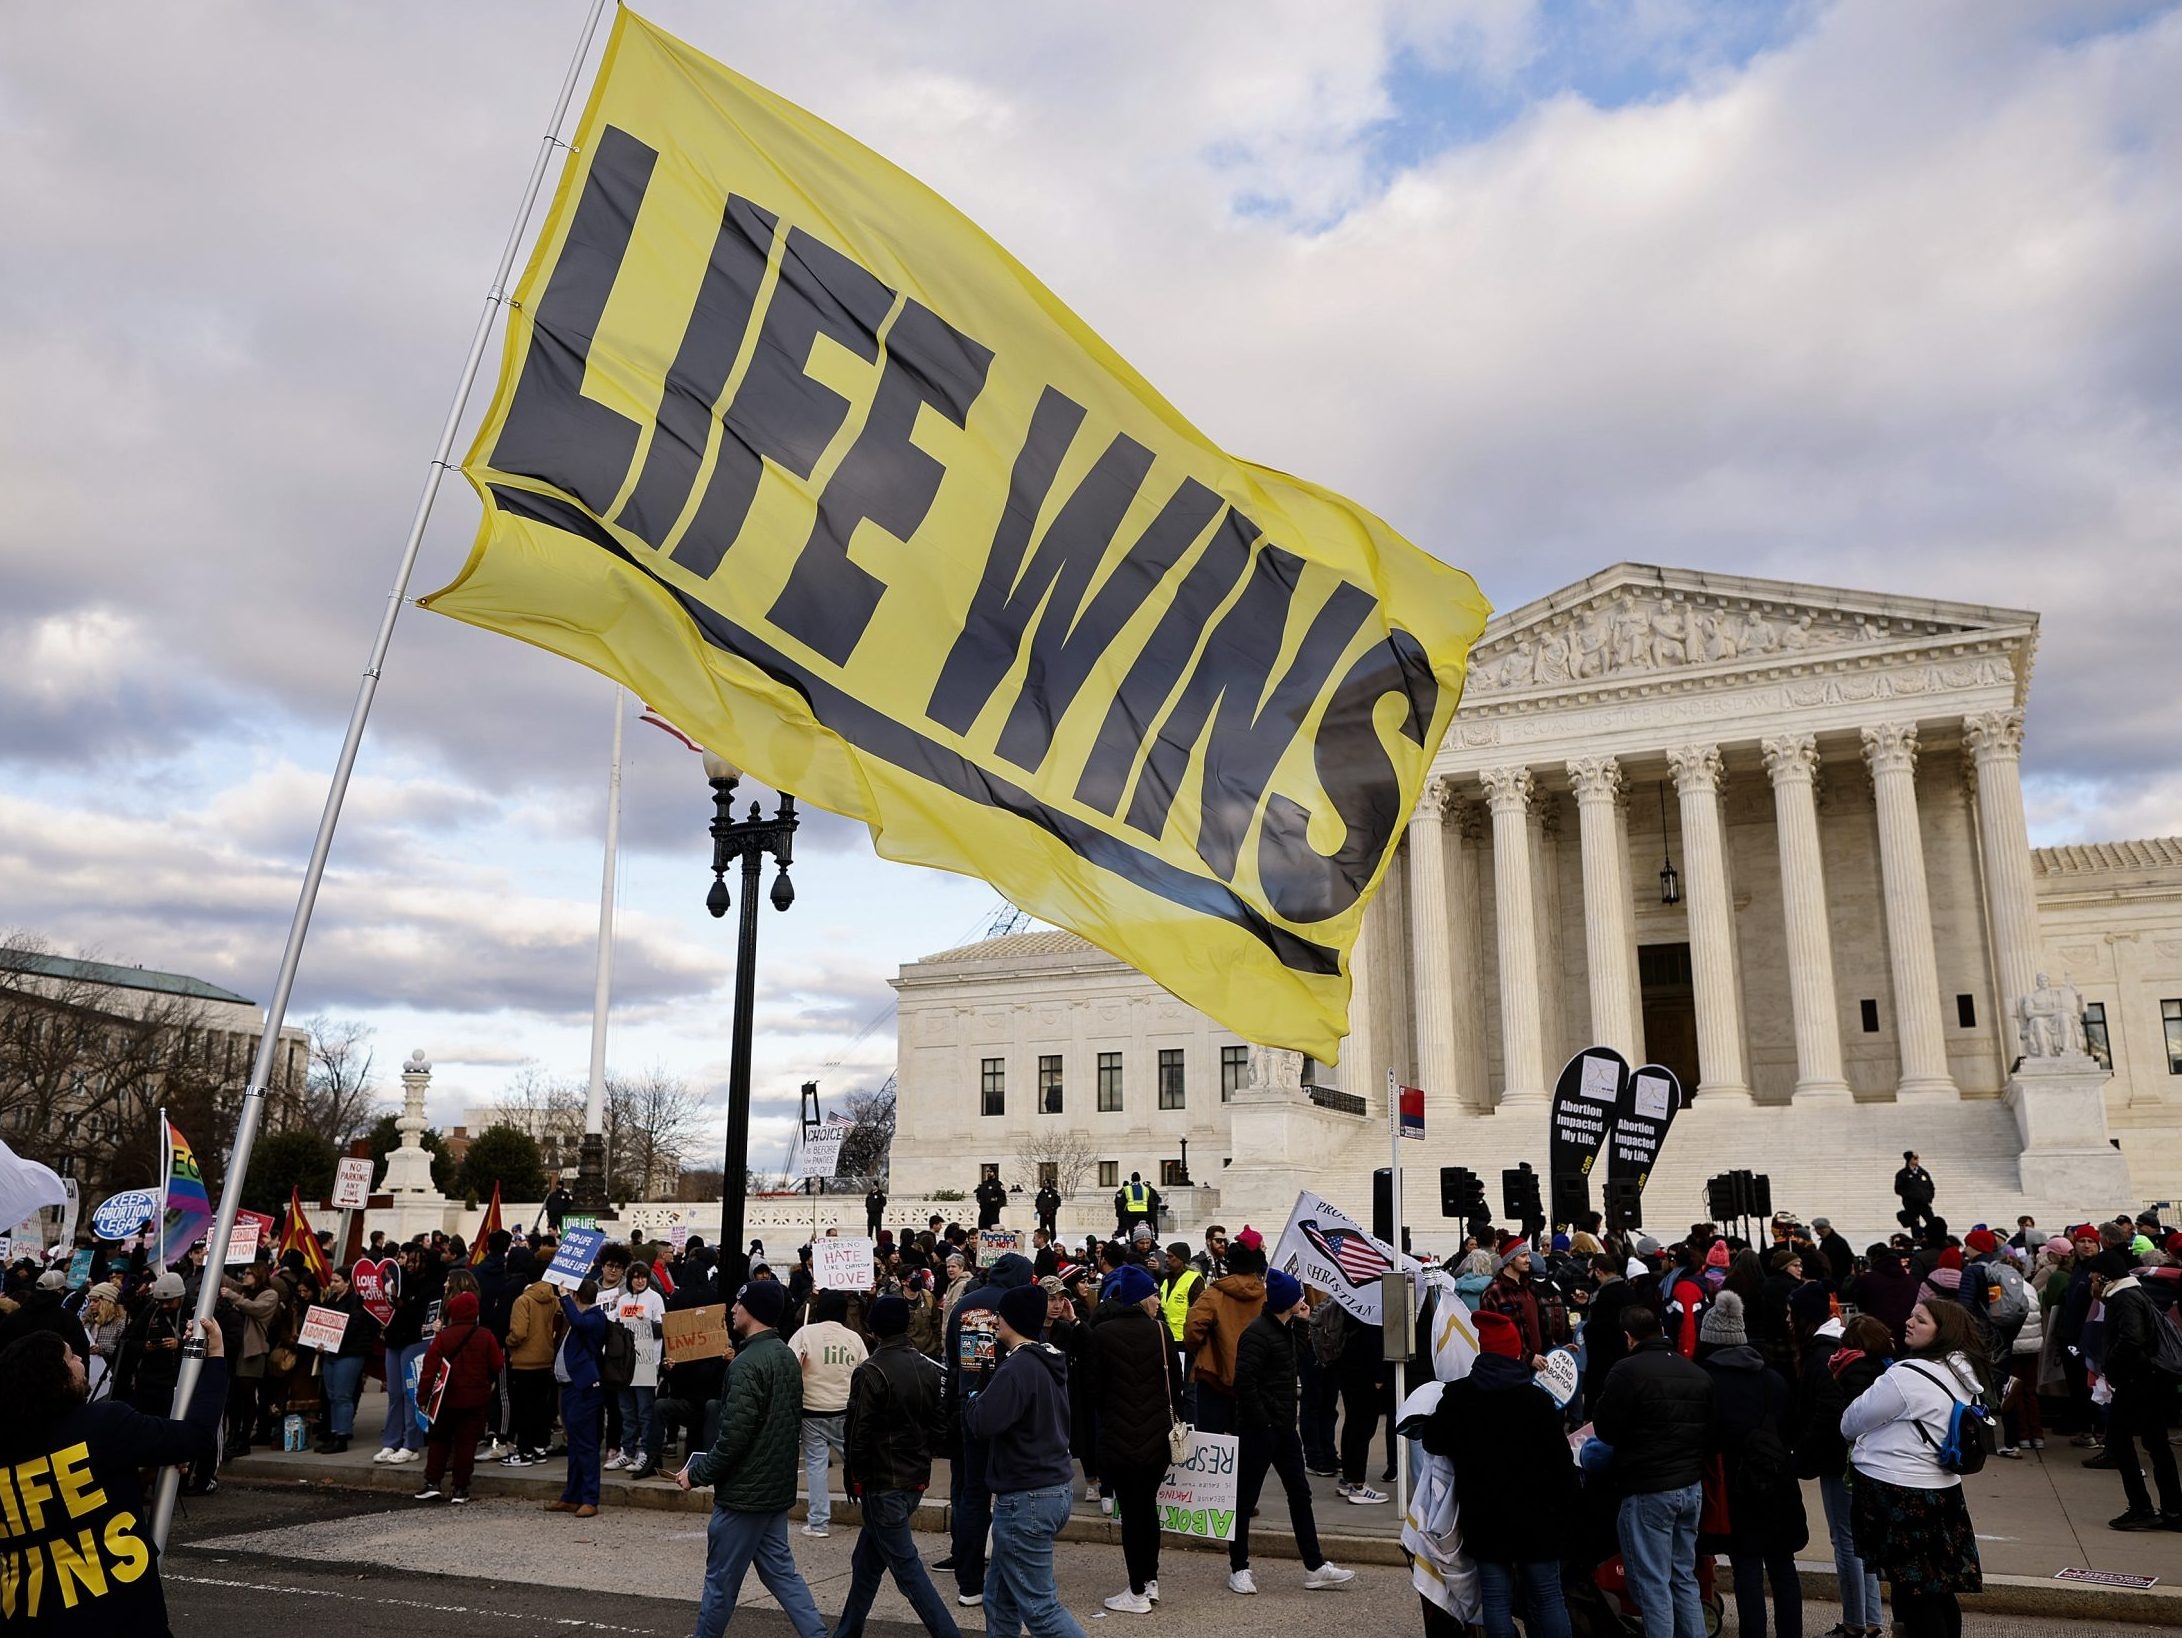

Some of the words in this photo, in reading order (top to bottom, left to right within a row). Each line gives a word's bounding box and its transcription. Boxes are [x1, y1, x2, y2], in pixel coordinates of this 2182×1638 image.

[490, 124, 995, 668] LIFE
[924, 384, 1438, 924] WINS
[1512, 715, 1575, 738] EQUAL
[1578, 708, 1651, 729] JUSTICE
[1659, 699, 1728, 719] UNDER
[1734, 693, 1770, 712] LAW
[1560, 1100, 1603, 1118] Abortion
[1557, 1114, 1603, 1133] Impacted
[1617, 1118, 1655, 1136] Abortion
[807, 1126, 843, 1142] CHOICE
[1561, 1129, 1575, 1143] My
[1577, 1131, 1597, 1146] Life.
[1615, 1132, 1656, 1150] Impacted
[813, 1145, 838, 1155] BEFORE
[1619, 1148, 1632, 1160] My
[1633, 1150, 1651, 1163] Life.
[350, 1163, 362, 1172] NO
[340, 1171, 369, 1182] PARKING
[110, 1193, 147, 1207] KEEP
[97, 1204, 152, 1220] ABORTION
[99, 1217, 144, 1233] LEGAL
[563, 1217, 580, 1230] LOVE
[582, 1217, 596, 1230] LIFE
[565, 1232, 594, 1246] PRO-LIFE
[980, 1231, 1016, 1242] America
[559, 1244, 573, 1255] FOR
[571, 1246, 586, 1258] THE
[825, 1250, 863, 1264] HATE
[552, 1256, 575, 1269] WHOLE
[573, 1261, 589, 1273] LIFE
[356, 1275, 378, 1287] LOVE
[829, 1271, 868, 1287] LOVE
[360, 1289, 385, 1300] BOTH
[1307, 1263, 1375, 1317] CHRISTIAN
[303, 1323, 343, 1344] ABORTION
[667, 1332, 708, 1351] LAWS
[823, 1345, 855, 1368] life
[1558, 1352, 1573, 1368] PRAY
[1553, 1358, 1561, 1369] TO
[1561, 1366, 1573, 1380] END
[1546, 1364, 1573, 1393] ABORTION
[0, 1441, 108, 1539] IFE
[1158, 1490, 1193, 1503] TAKING
